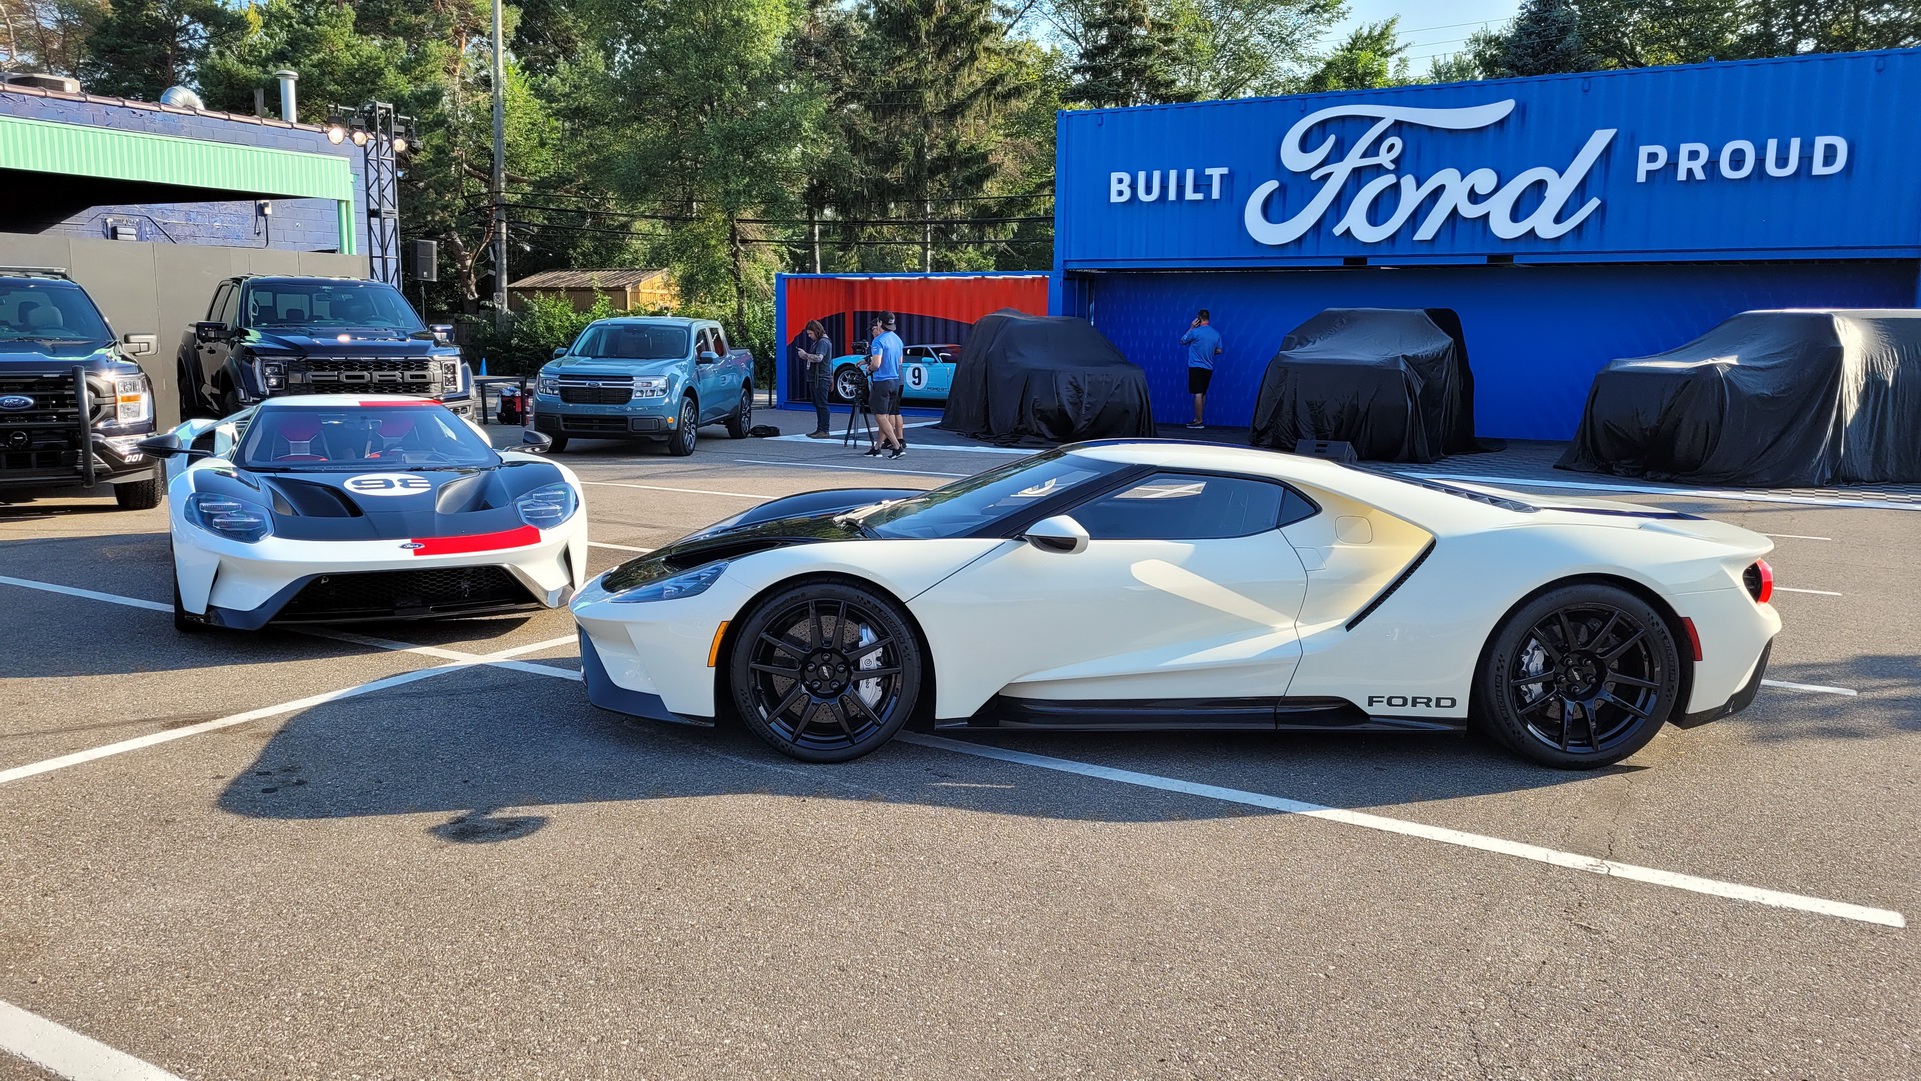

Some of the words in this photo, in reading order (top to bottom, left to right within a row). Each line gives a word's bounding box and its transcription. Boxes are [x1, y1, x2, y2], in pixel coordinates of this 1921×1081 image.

[1109, 167, 1229, 203] BUILT
[1244, 99, 1617, 246] Ford
[1636, 135, 1848, 183] PROUD
[304, 371, 433, 384] FORD
[911, 367, 922, 386] 9
[125, 454, 143, 462] 001
[1367, 696, 1457, 708] FORD
